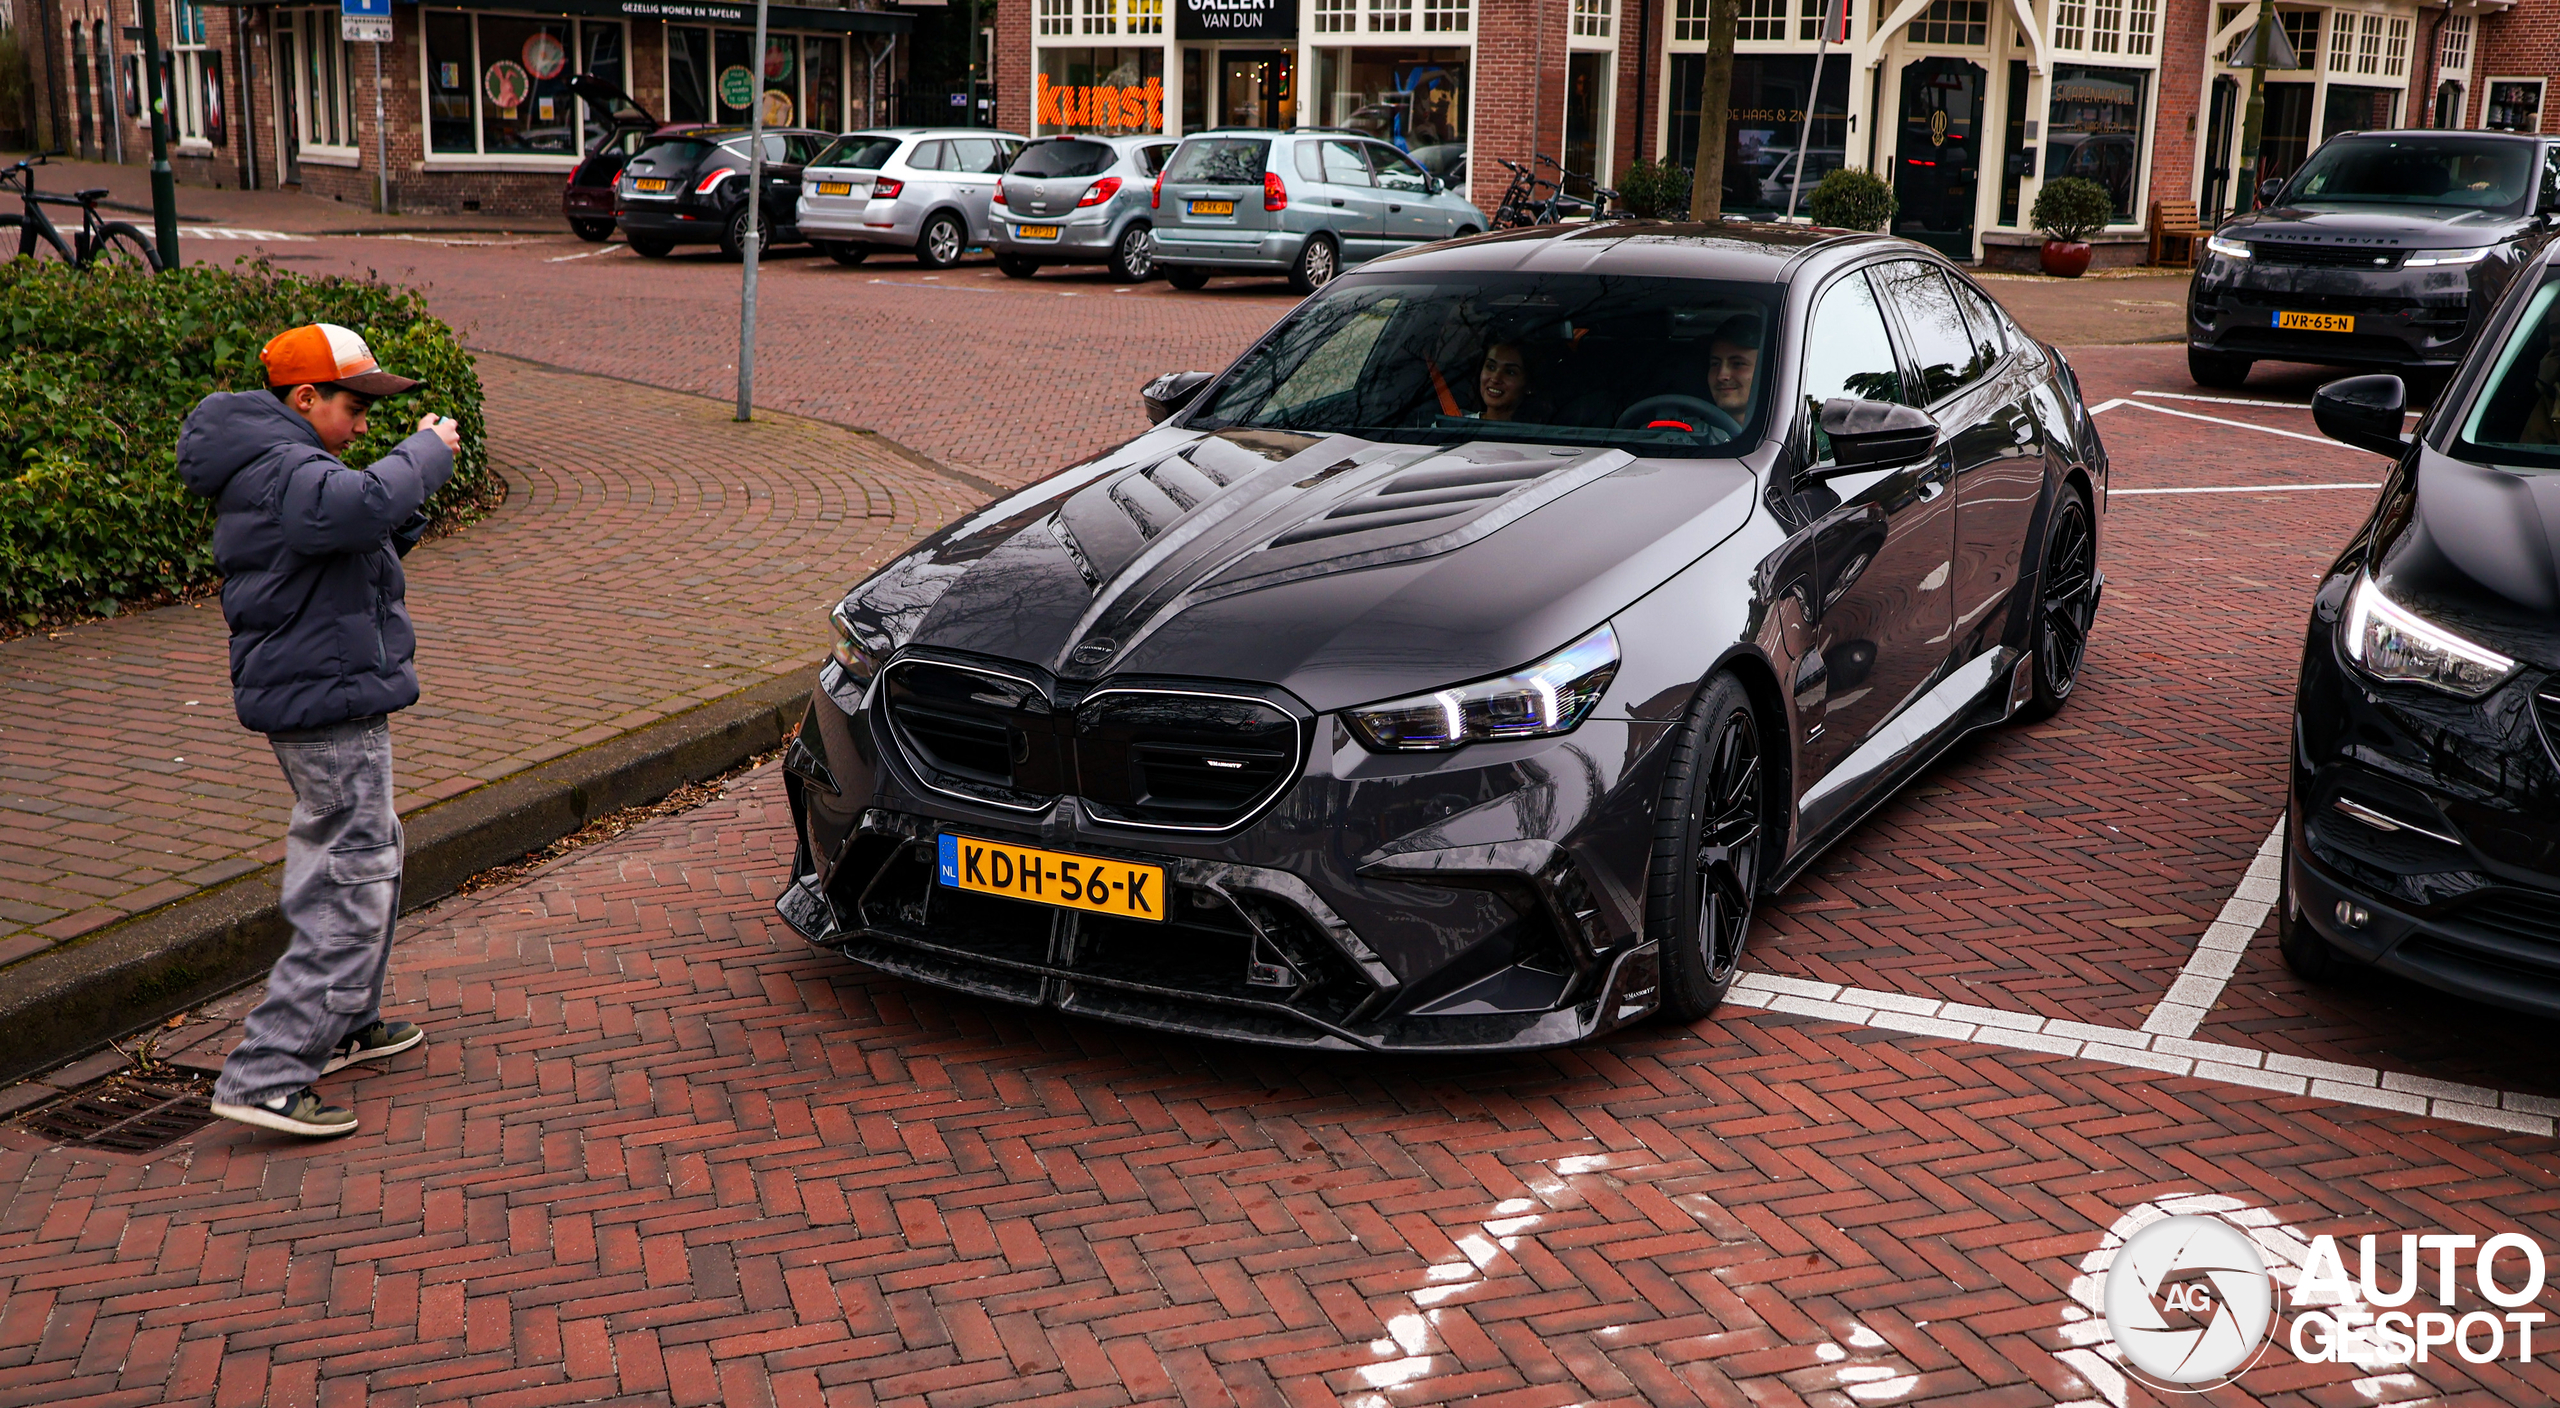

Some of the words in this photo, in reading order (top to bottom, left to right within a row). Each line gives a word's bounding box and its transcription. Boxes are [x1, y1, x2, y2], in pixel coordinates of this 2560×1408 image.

[621, 2, 659, 14] GEZELLIG
[661, 5, 692, 16] WONEN
[694, 6, 706, 17] EN
[708, 7, 741, 19] TAFELEN
[1202, 12, 1229, 28] VAN
[1233, 12, 1263, 28] DUN
[1037, 73, 1164, 129] kunst
[1726, 108, 1740, 121] DE
[1742, 109, 1774, 121] HAAS
[1776, 108, 1786, 122] &
[1848, 113, 1857, 134] 1
[1194, 201, 1230, 213] 80-RK-JN
[2264, 233, 2322, 242] RANGE
[2335, 236, 2400, 245] ROVER
[2282, 313, 2349, 331] JVR-65-N
[942, 865, 956, 878] NL
[964, 845, 1153, 913] KDH-56-K
